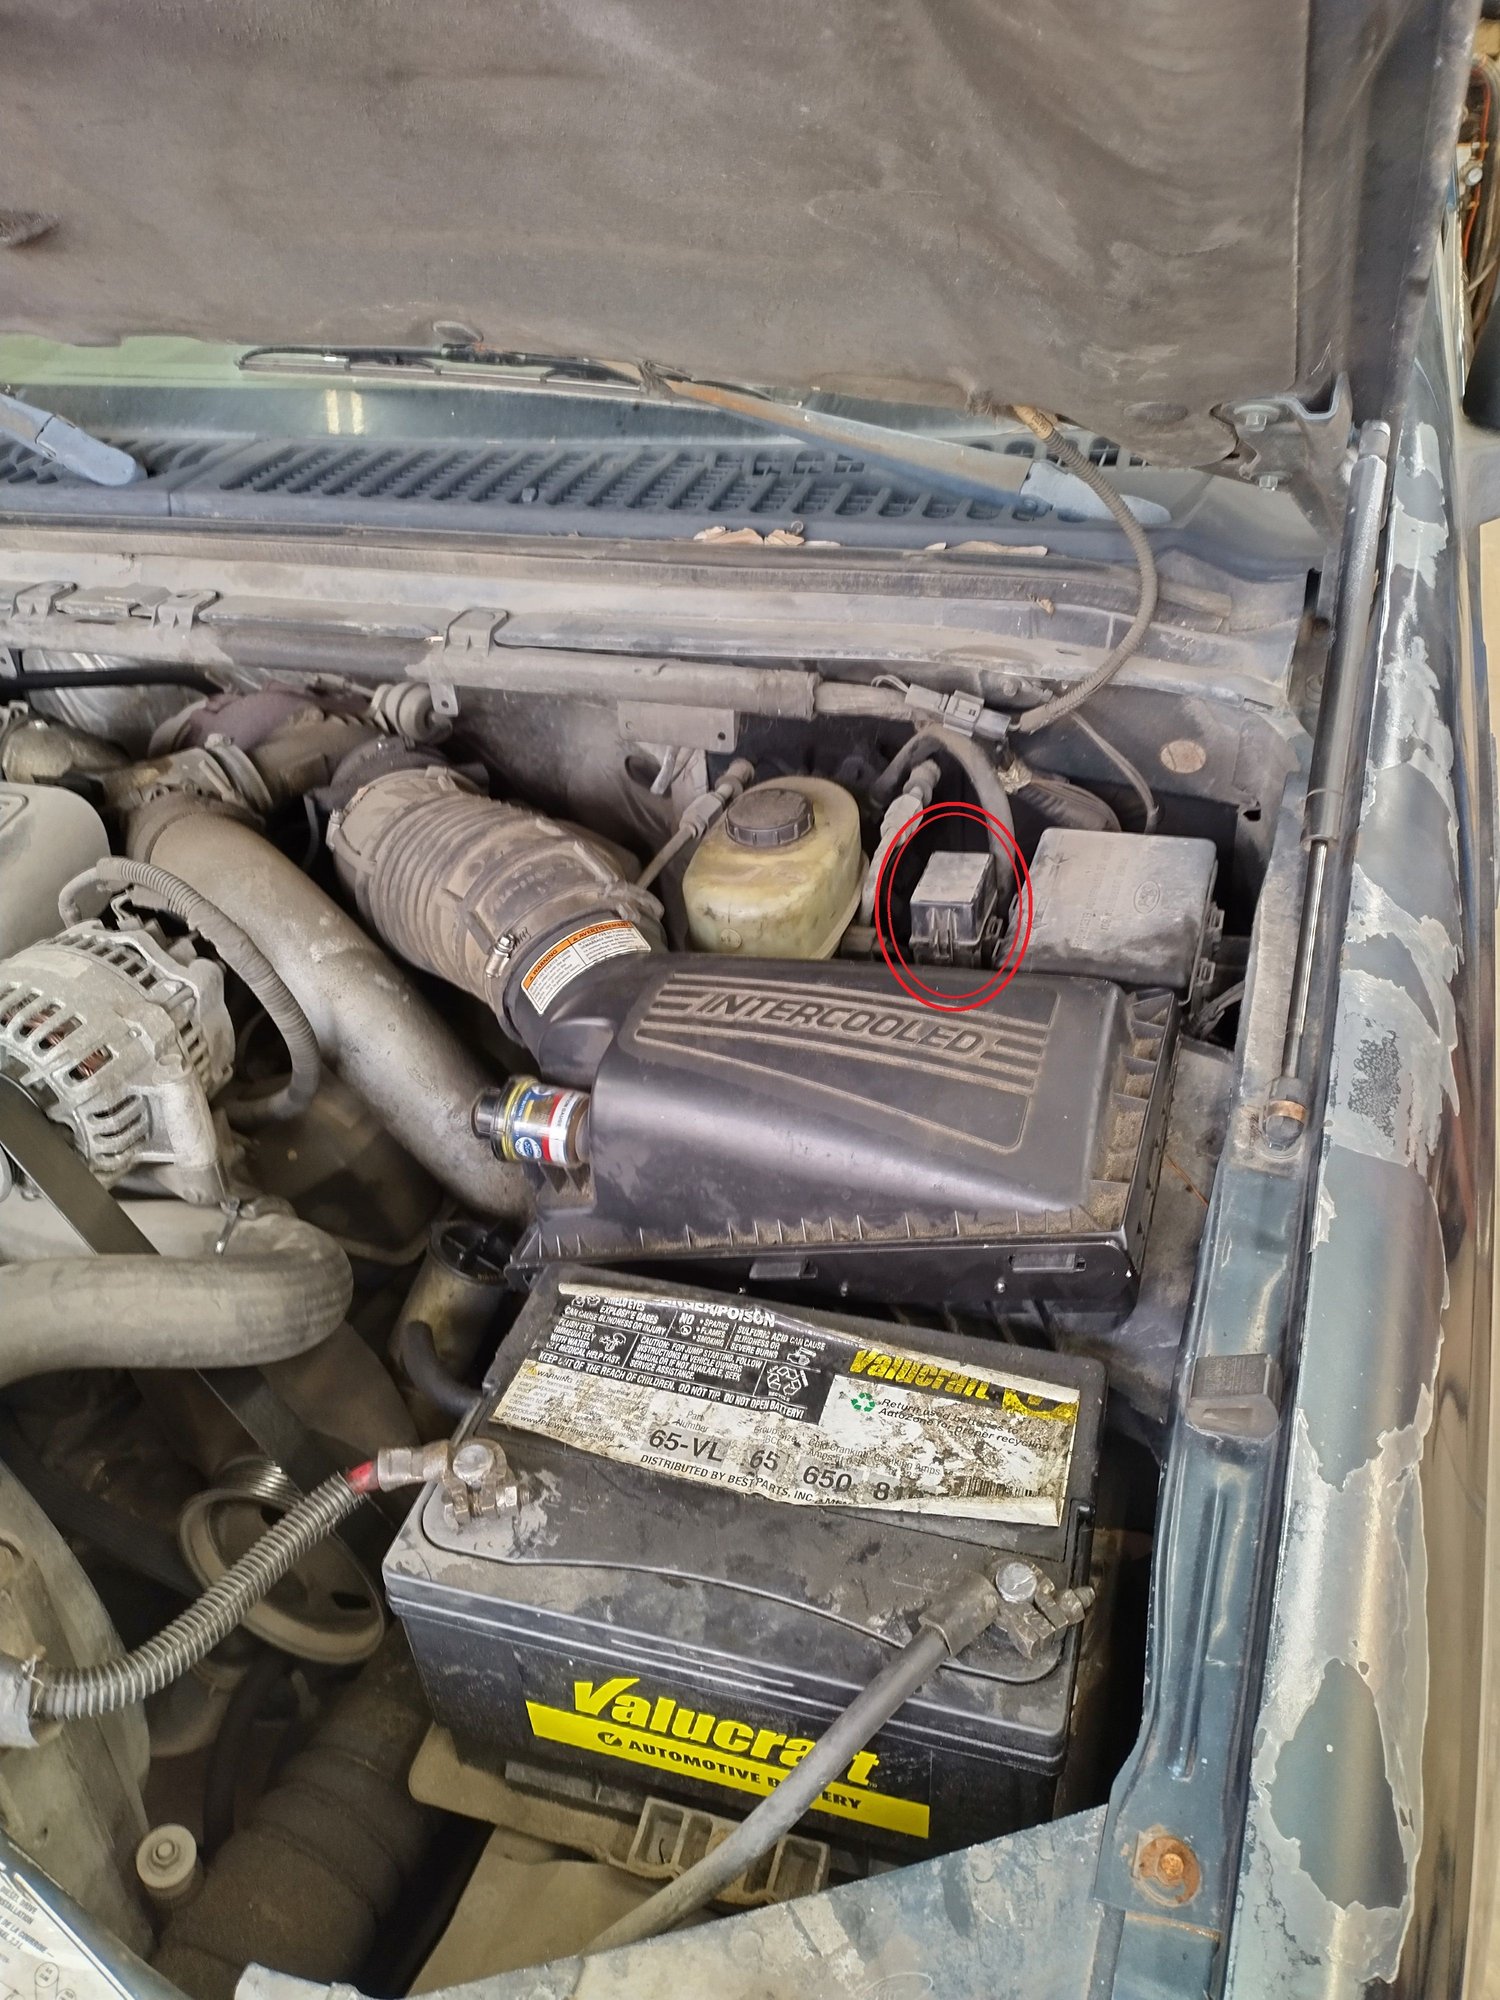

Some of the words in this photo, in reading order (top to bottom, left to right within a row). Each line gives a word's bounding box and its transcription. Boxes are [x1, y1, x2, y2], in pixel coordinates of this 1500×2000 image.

[533, 950, 558, 975] WARNING
[699, 994, 984, 1052] INTERCOOLED
[564, 1305, 579, 1316] CAN
[598, 1314, 633, 1328] BLINDNESS
[631, 1321, 642, 1331] OR
[641, 1323, 667, 1336] INJURY
[578, 1321, 596, 1332] EYES
[635, 1311, 660, 1325] GASES
[679, 1312, 695, 1325] NO
[703, 1318, 730, 1331] SPARKS
[550, 1333, 568, 1344] WITH
[554, 1326, 597, 1341] IMMEDIATELY
[696, 1335, 724, 1347] SMOKING
[734, 1335, 769, 1347] BLINDNESS
[769, 1340, 780, 1349] OR
[737, 1325, 771, 1340] SULFURIC
[771, 1332, 789, 1343] ACID
[803, 1339, 826, 1350] CAUSE
[559, 1343, 586, 1356] MEDICAL
[586, 1349, 602, 1360] HELP
[636, 1343, 681, 1361] INSTRUCTIONS
[681, 1352, 689, 1361] IN
[688, 1354, 716, 1367] VEHICLE
[715, 1360, 743, 1373] OWNERS
[640, 1336, 671, 1349] CAUTION:
[671, 1342, 685, 1352] FOR
[684, 1345, 703, 1356] JUMP
[735, 1356, 763, 1369] FOLLOW
[730, 1343, 756, 1355] SEVERE
[755, 1348, 779, 1359] BURNS
[537, 1370, 573, 1384] WARNING
[629, 1359, 656, 1373] SERVICE
[633, 1351, 659, 1365] MANUAL
[658, 1357, 669, 1367] OR
[669, 1359, 676, 1368] IF
[675, 1361, 689, 1371] NOT
[724, 1370, 742, 1382] SEEK
[538, 1351, 559, 1363] KEEP
[573, 1359, 586, 1370] OF
[586, 1362, 601, 1374] THE
[601, 1365, 626, 1379] REACH
[625, 1370, 638, 1382] OF
[637, 1374, 675, 1391] CHILDREN.
[678, 1383, 691, 1393] DO
[689, 1385, 707, 1398] NOT
[723, 1393, 736, 1405] DO
[734, 1395, 750, 1408] NOT
[750, 1399, 769, 1411] OPEN
[769, 1402, 805, 1419] BATTERY!
[881, 1398, 921, 1415] Return
[649, 1429, 725, 1463] 65-VL
[640, 1454, 709, 1478] DISTRIBUTED
[711, 1470, 727, 1482] BY
[727, 1474, 755, 1489] BEST
[750, 1449, 782, 1472] 65
[803, 1465, 853, 1493] 650
[574, 1678, 880, 1786] Valucrat
[628, 1740, 761, 1785] AUTOMOTIVE
[767, 1776, 863, 1811] BERY
